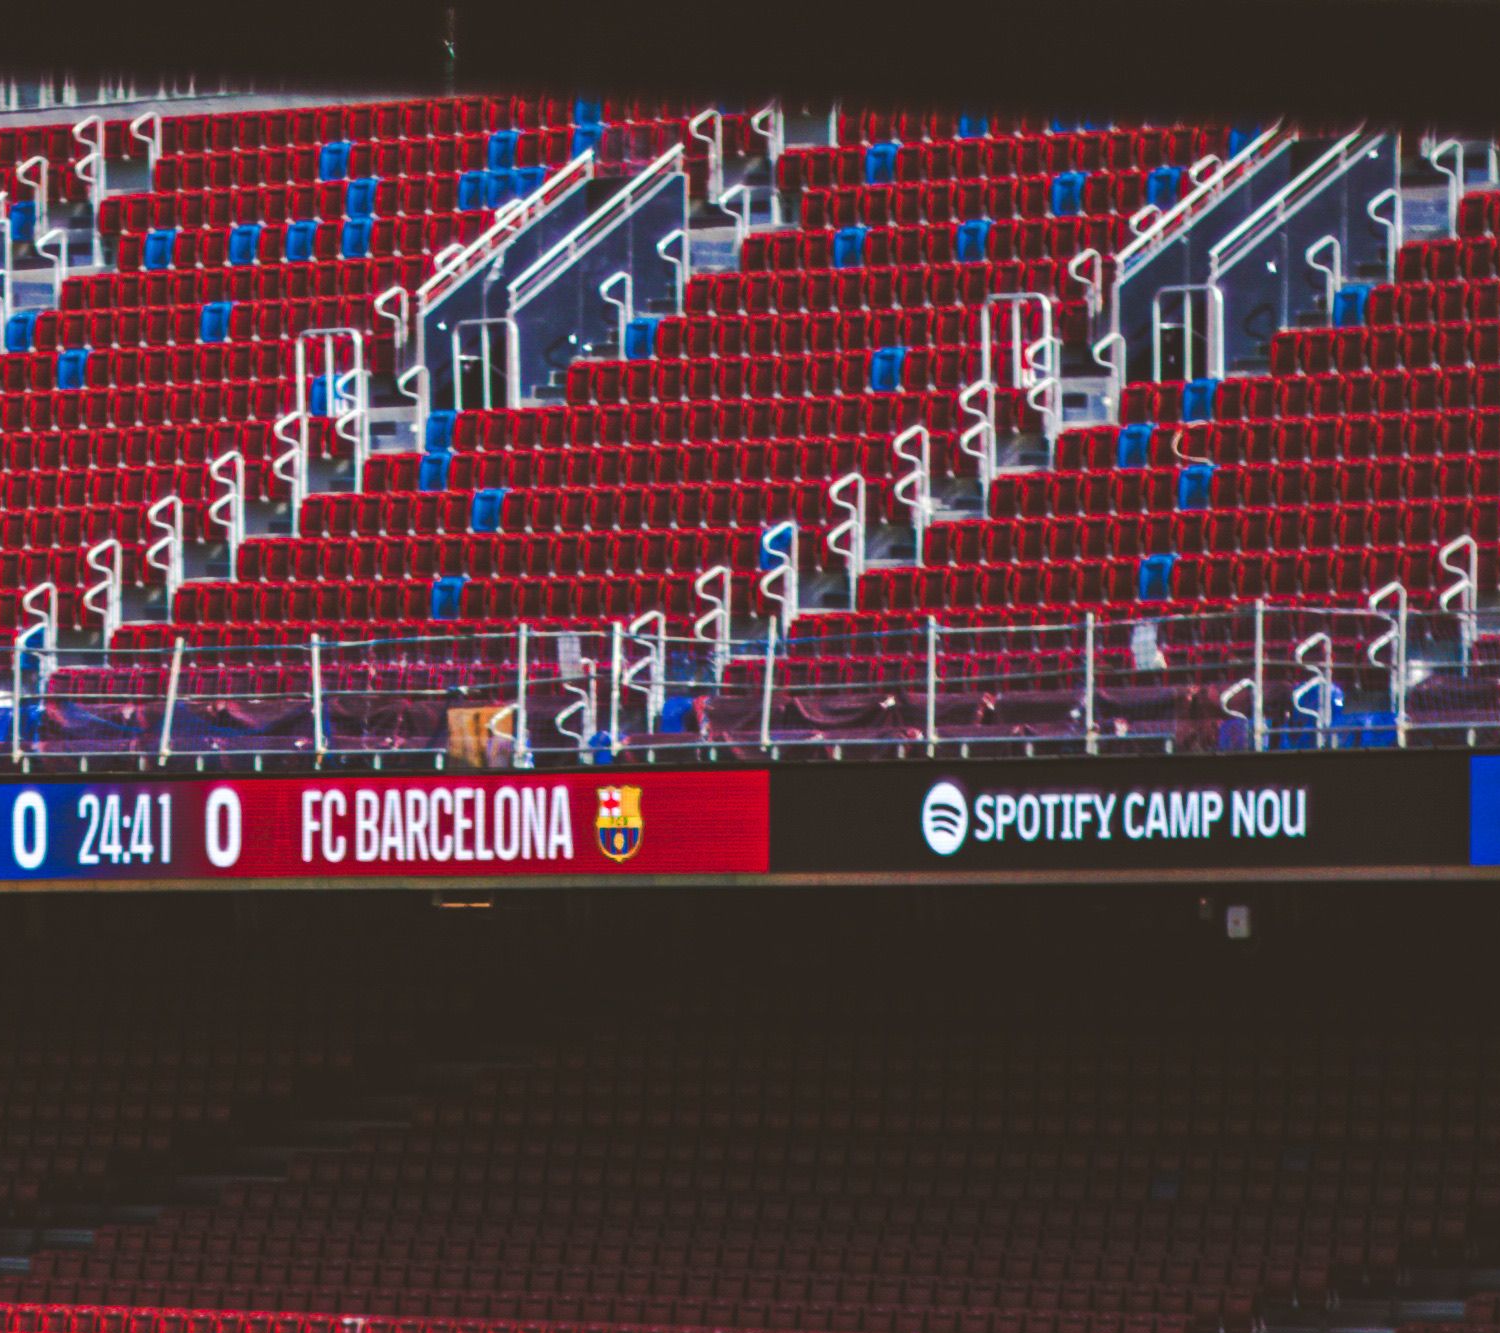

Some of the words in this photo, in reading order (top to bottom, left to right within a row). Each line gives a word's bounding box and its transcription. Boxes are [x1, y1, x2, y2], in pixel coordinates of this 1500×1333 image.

[12, 790, 48, 869] 0
[77, 793, 172, 865] 24:41
[205, 787, 243, 868] 0
[302, 789, 347, 863] FC
[354, 785, 575, 862] BARCELONA
[974, 793, 1117, 841] SPOTIFY
[1123, 791, 1224, 840] CAMP
[1230, 788, 1307, 838] NOU
